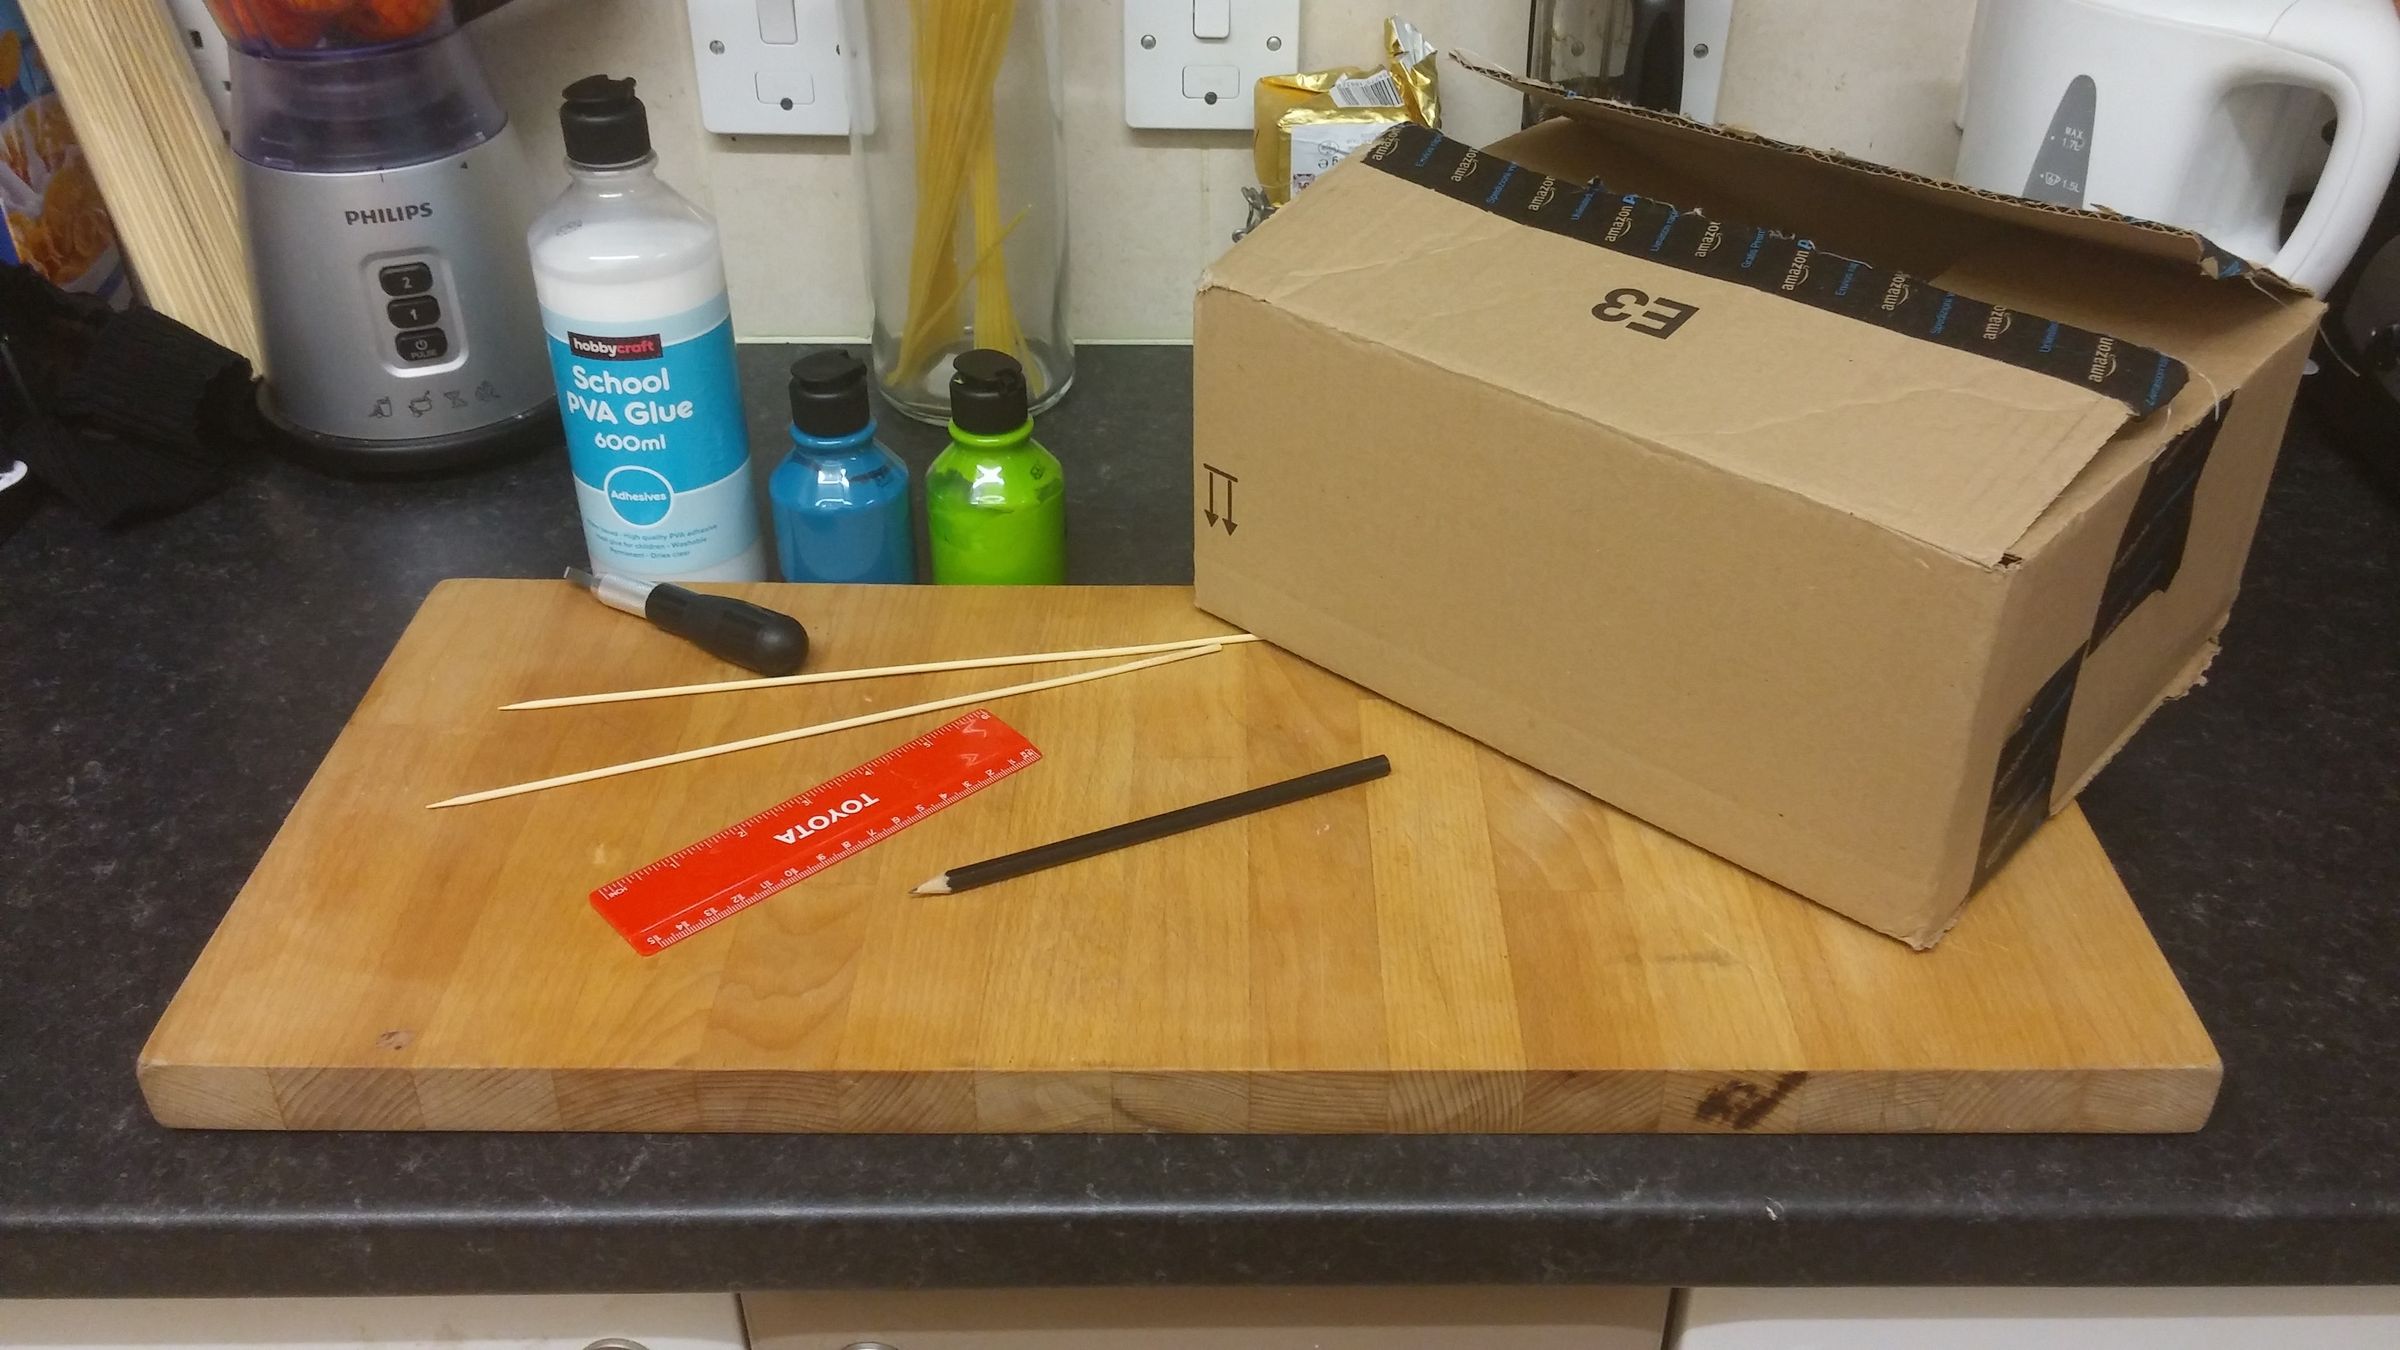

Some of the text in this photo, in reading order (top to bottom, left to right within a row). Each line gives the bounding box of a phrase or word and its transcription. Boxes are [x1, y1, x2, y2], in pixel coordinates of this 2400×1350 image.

[2065, 126, 2084, 139] MAX
[2062, 180, 2080, 193] 1.5L
[345, 202, 433, 226] PHILIPS
[1605, 205, 1634, 242] amazon
[1782, 250, 1809, 291] amazon
[402, 277, 413, 289] 2
[410, 309, 418, 321] 1
[1591, 288, 1700, 340] E3
[1983, 305, 2007, 340] amazo
[573, 338, 655, 357] hobbycraft
[2089, 337, 2114, 383] amazon
[572, 365, 670, 394] School
[566, 390, 693, 426] PVA Glue
[594, 432, 667, 452] 600ml
[611, 490, 667, 502] Adhesives
[773, 792, 880, 845] TOYOTA
[730, 893, 746, 904] 12
[704, 906, 720, 918] 13
[647, 934, 663, 946] 15
